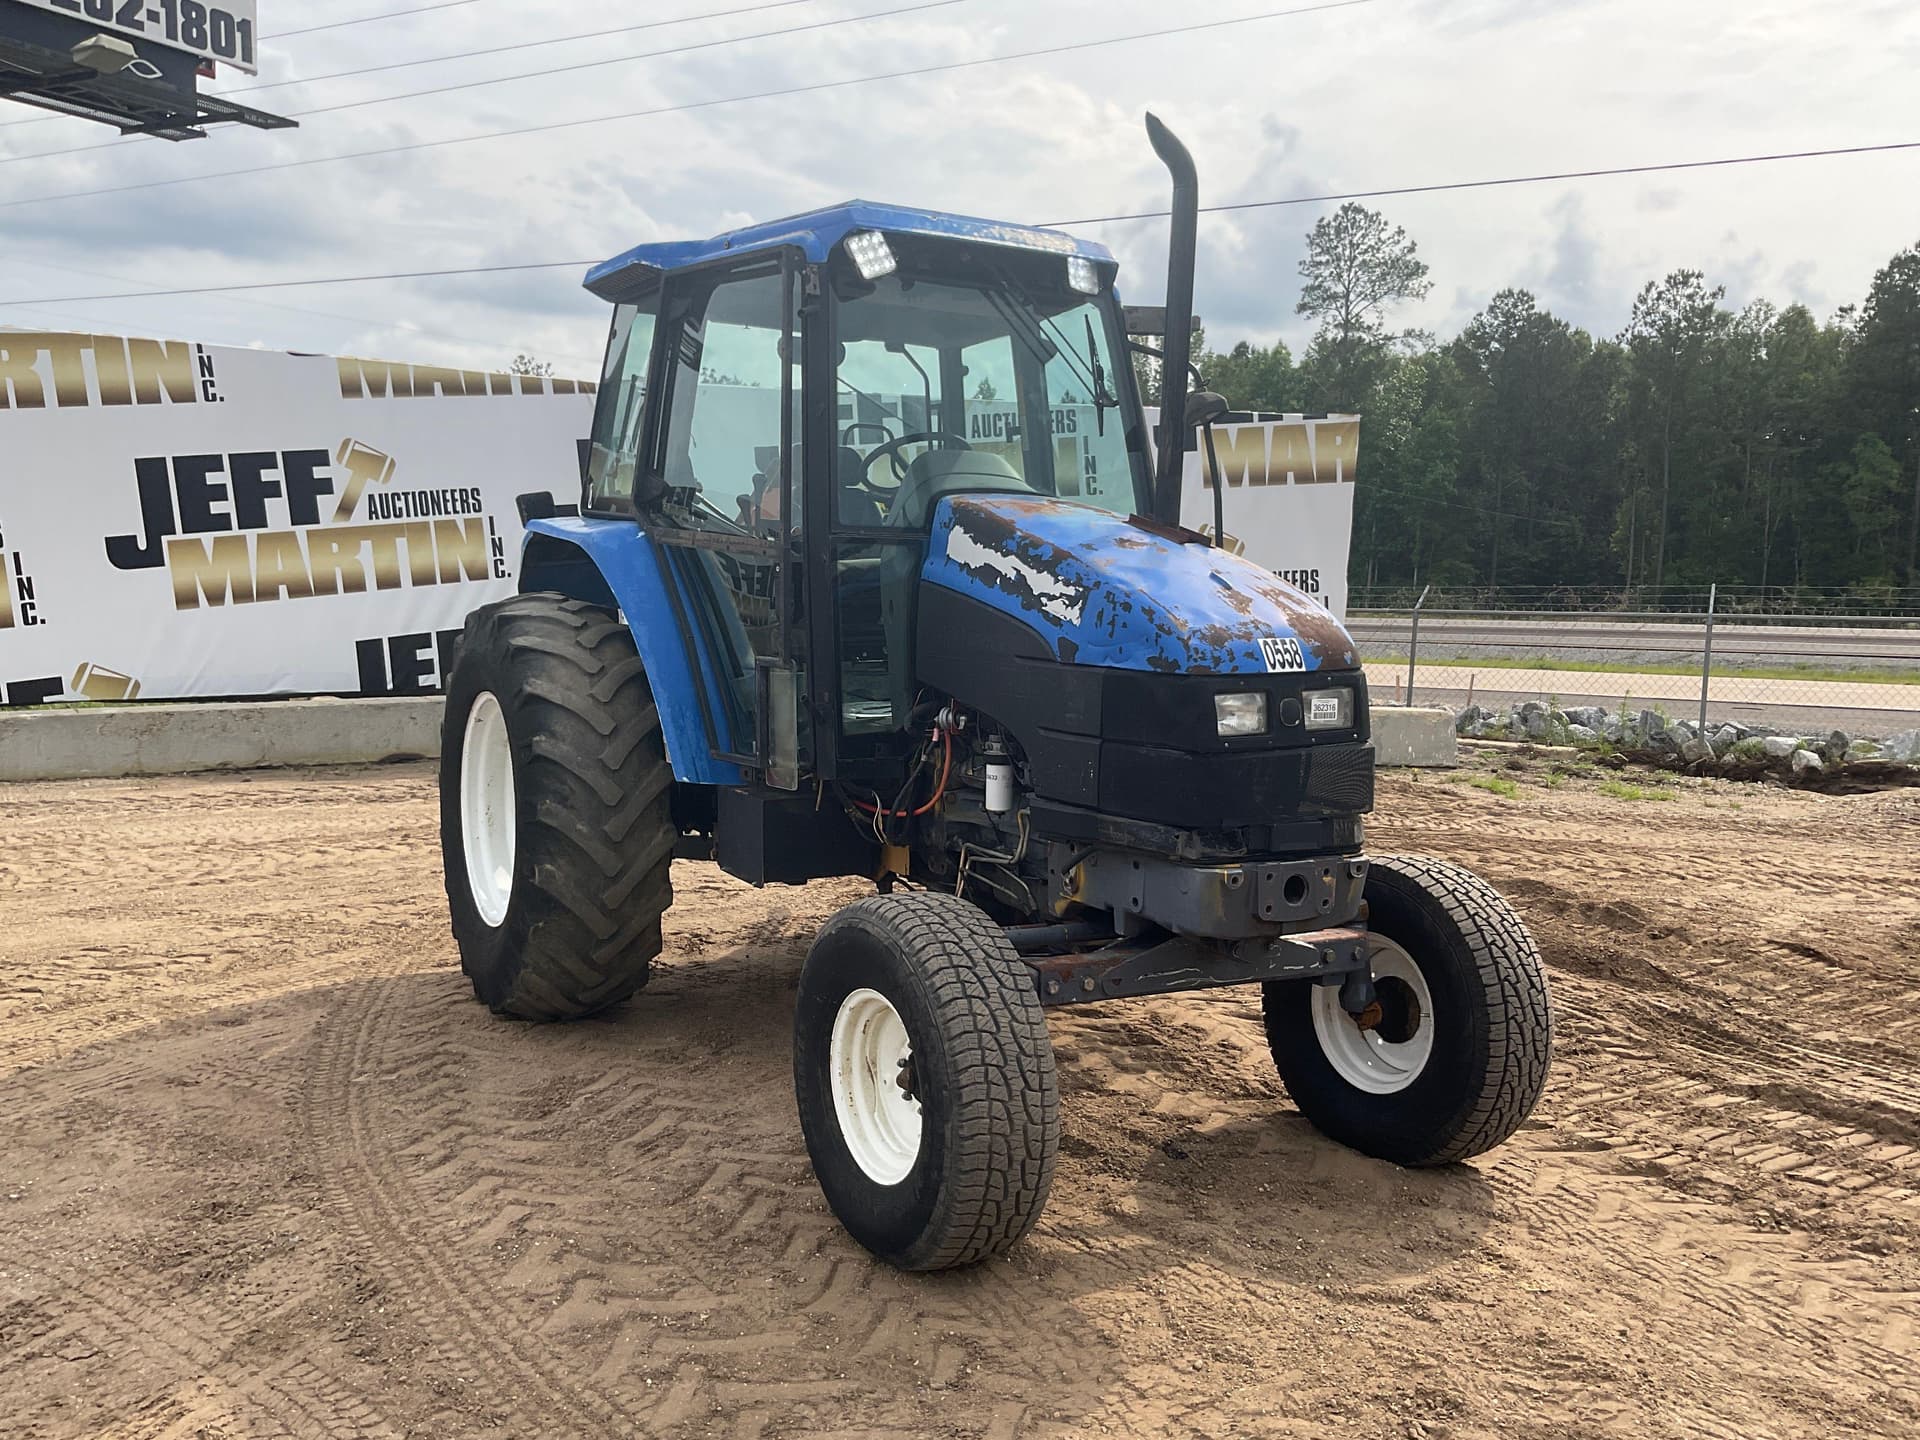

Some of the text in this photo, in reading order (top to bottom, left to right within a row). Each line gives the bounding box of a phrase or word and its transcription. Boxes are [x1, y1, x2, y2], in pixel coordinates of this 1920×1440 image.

[105, 449, 334, 570] JEFF
[368, 487, 482, 520] AUCTIONEERS
[167, 517, 489, 610] MARTIN
[488, 515, 512, 579] INC.
[13, 551, 46, 627] INC.
[1263, 639, 1303, 670] 0558
[1313, 703, 1336, 711] 362316
